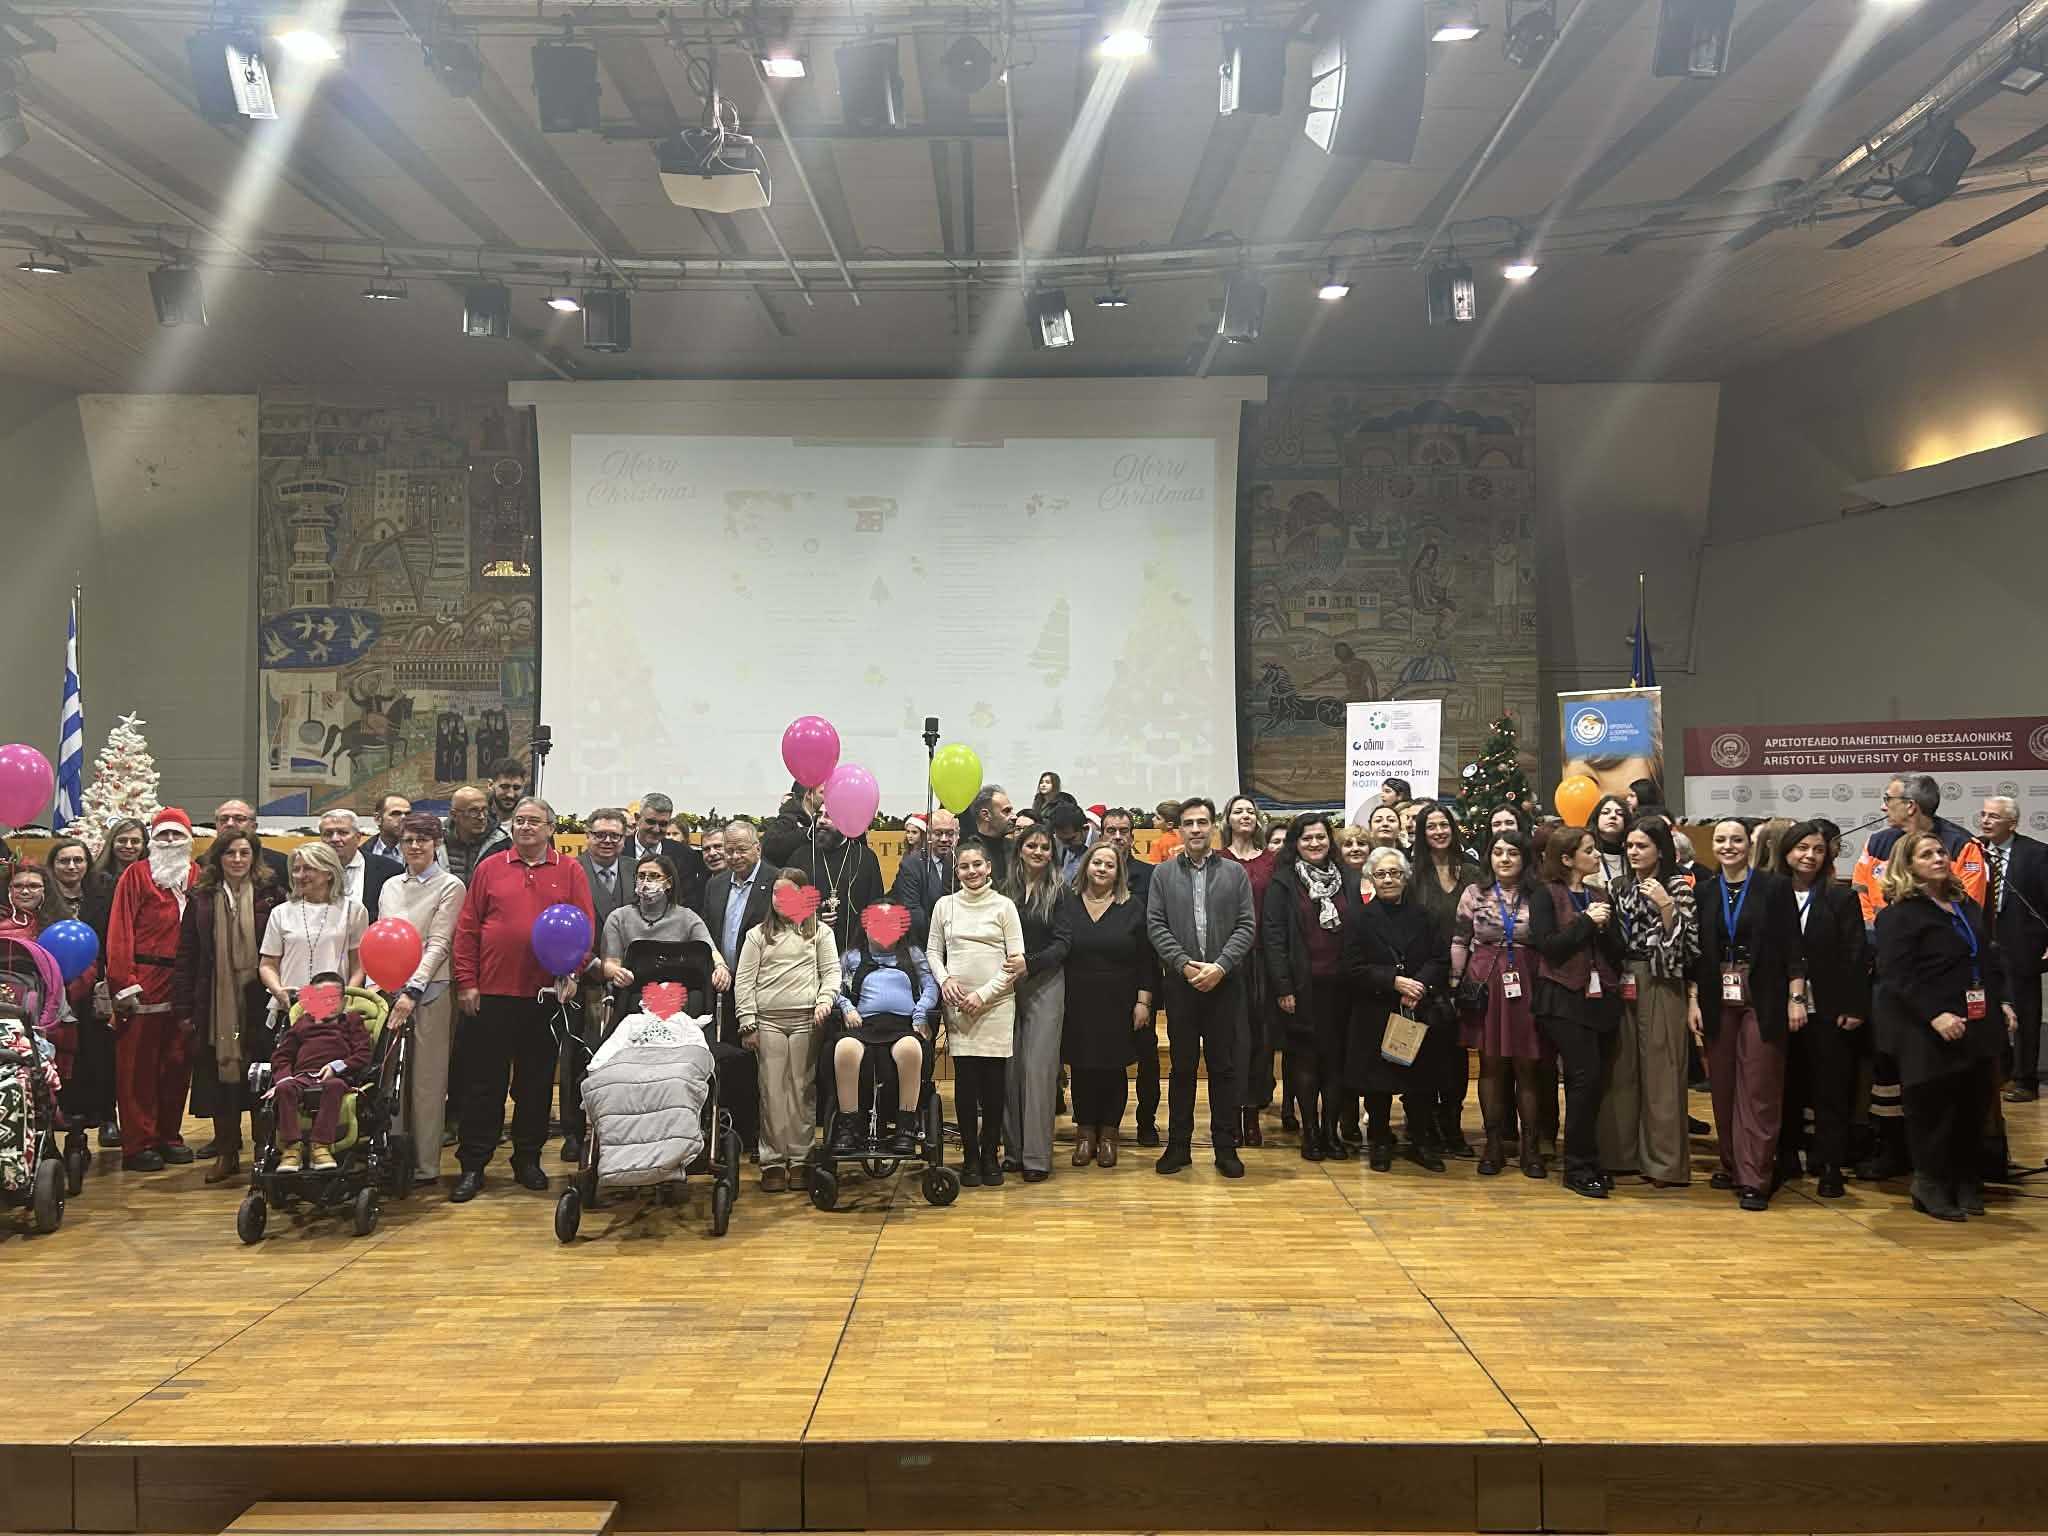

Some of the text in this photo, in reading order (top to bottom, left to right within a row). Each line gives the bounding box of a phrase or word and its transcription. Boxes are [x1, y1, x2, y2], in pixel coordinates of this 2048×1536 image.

[600, 448, 680, 482] Merry
[1112, 453, 1188, 485] Merry
[586, 479, 697, 506] Christmas
[1098, 481, 1206, 511] Christmas
[1765, 732, 2013, 747] ΑΡΙΣΤΟΤΕΛΕΙΟ ΠΑΝΕΠΙΣΤΗΜΙΟ ΘΕΣΣΑΛΟΝΙΚΗΣ
[1763, 750, 2013, 766] ARISTOTLE UNIVERSITY OF THESSALONIKI
